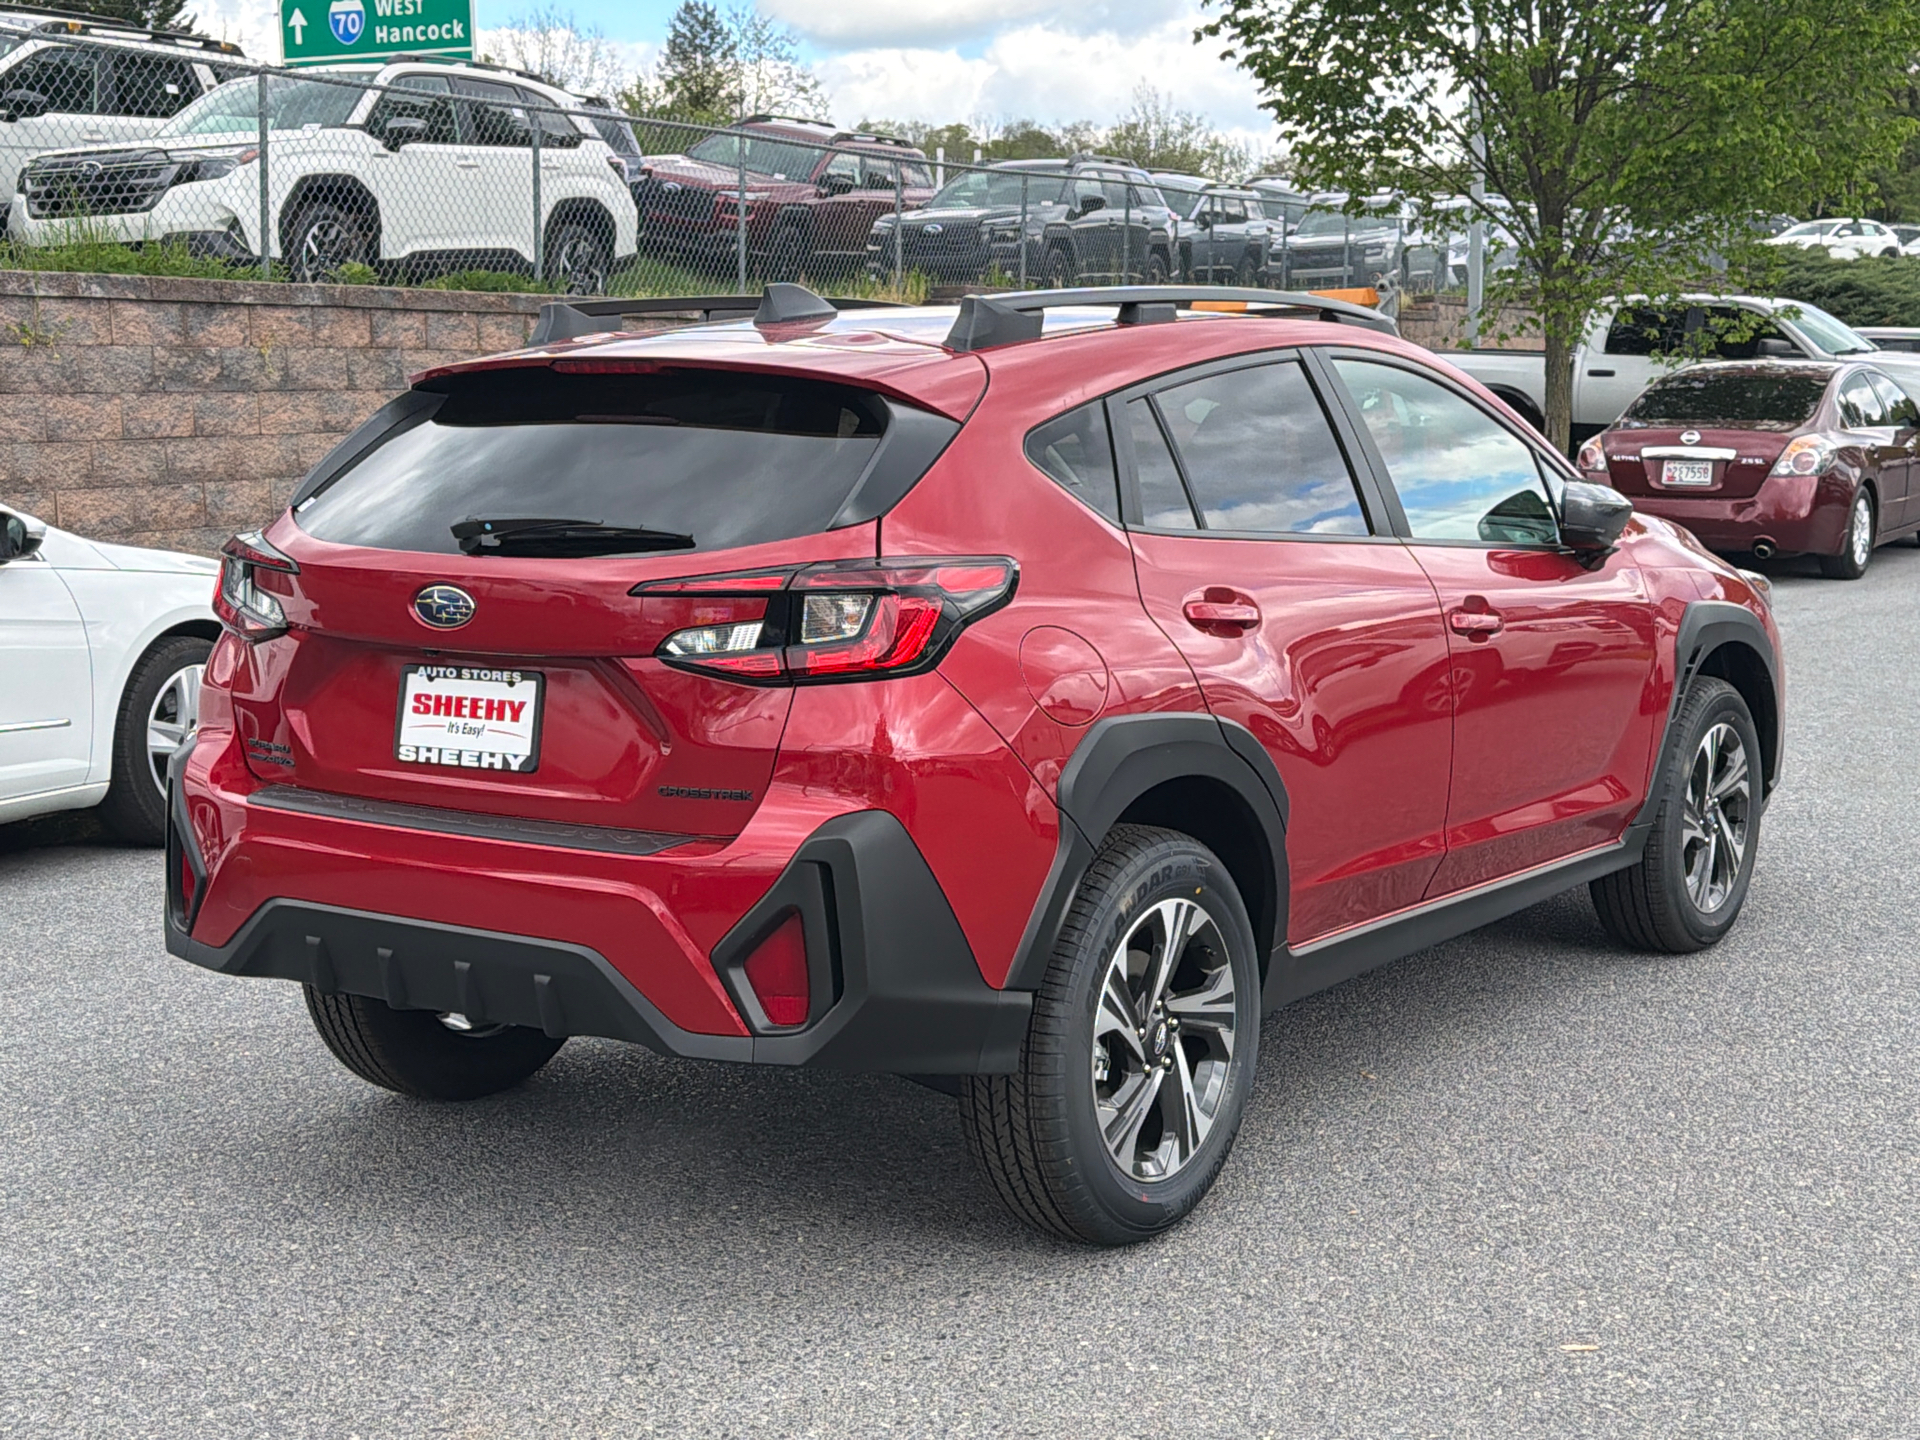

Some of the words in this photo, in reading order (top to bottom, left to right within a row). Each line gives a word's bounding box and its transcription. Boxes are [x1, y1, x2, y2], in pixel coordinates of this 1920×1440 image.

[374, 0, 423, 17] WEST
[335, 13, 360, 35] 70
[375, 19, 464, 44] Hancock
[417, 666, 457, 678] AUTO
[461, 668, 522, 682] STORES
[411, 693, 527, 723] SHEEHY
[447, 721, 460, 735] It's
[461, 723, 486, 739] Easy!
[398, 745, 529, 771] SHEEHY
[657, 785, 754, 802] CROSSTREK
